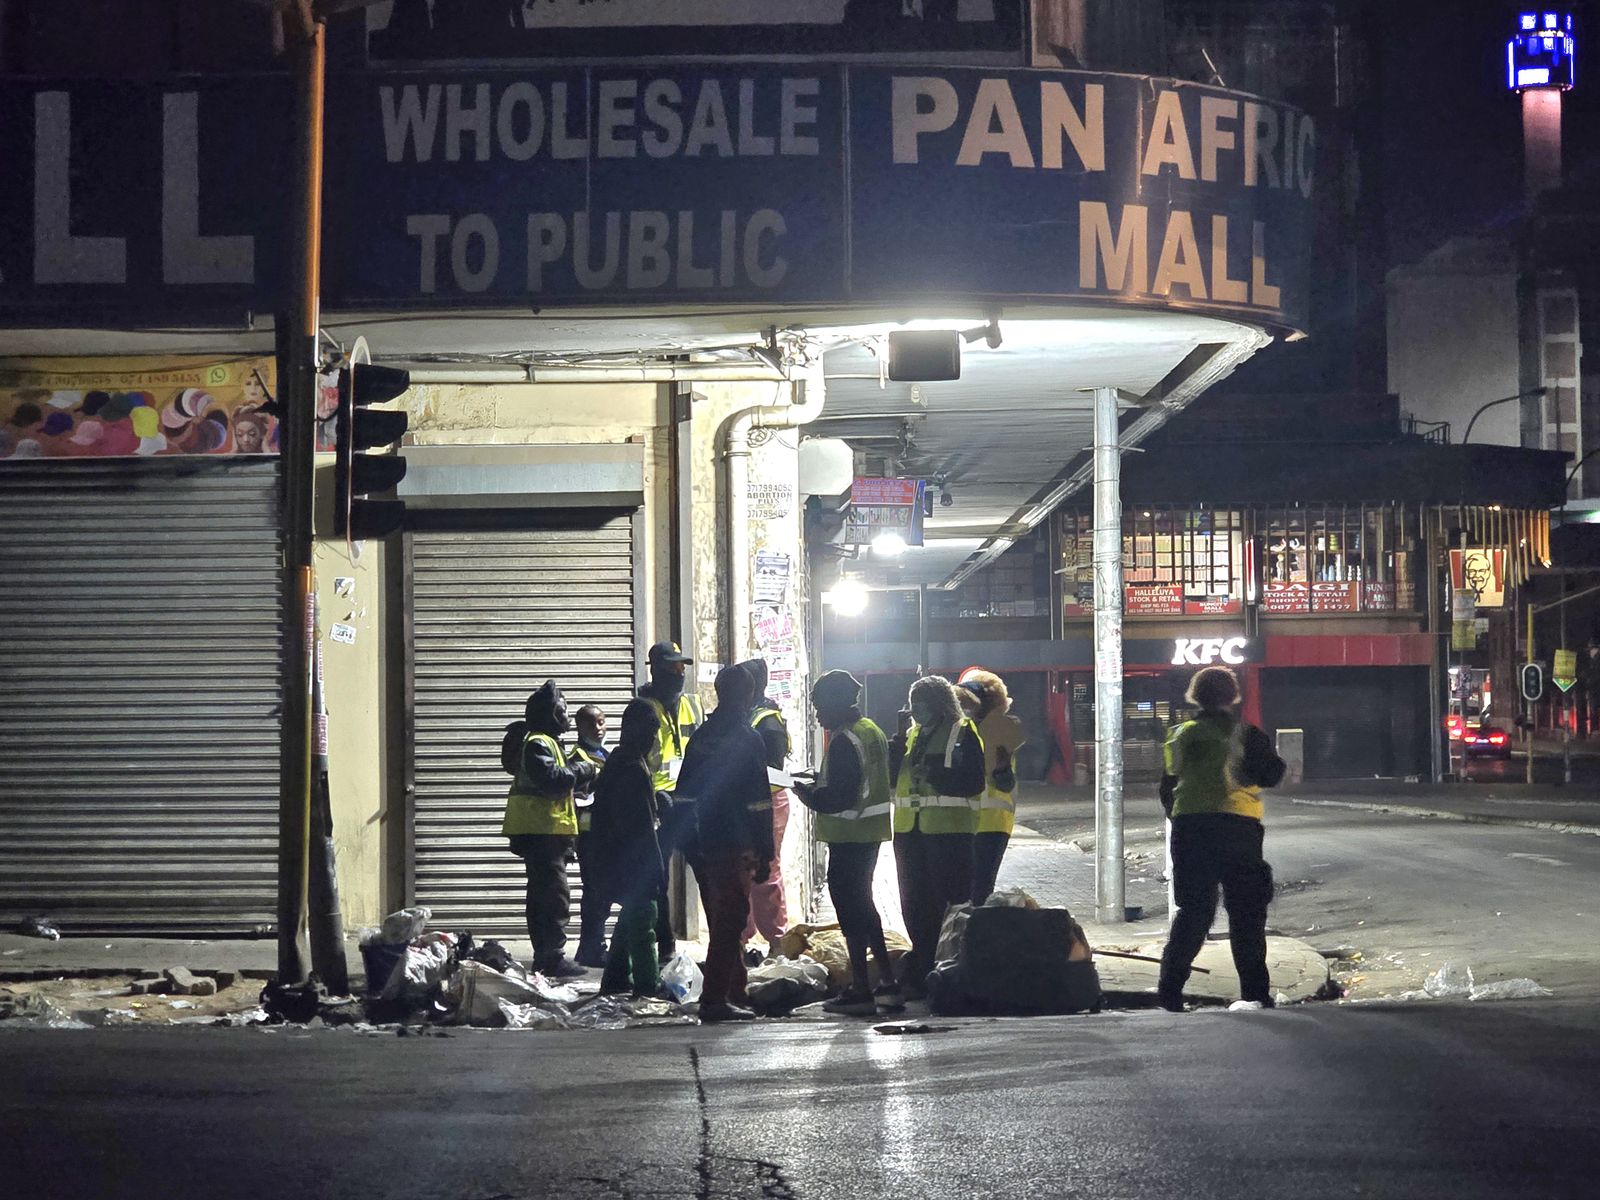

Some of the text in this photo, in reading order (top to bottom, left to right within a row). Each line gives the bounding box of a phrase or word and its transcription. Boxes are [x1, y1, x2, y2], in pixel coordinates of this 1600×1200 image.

[379, 78, 819, 163] WHOLESALE
[891, 76, 1105, 172] PAN
[0, 90, 255, 284] LL
[406, 208, 789, 293] TO PUBLIC
[1079, 200, 1281, 308] MALL
[1134, 588, 1174, 596] HALLELUYA
[1263, 583, 1349, 591] DAGI
[1171, 637, 1248, 665] KFC
